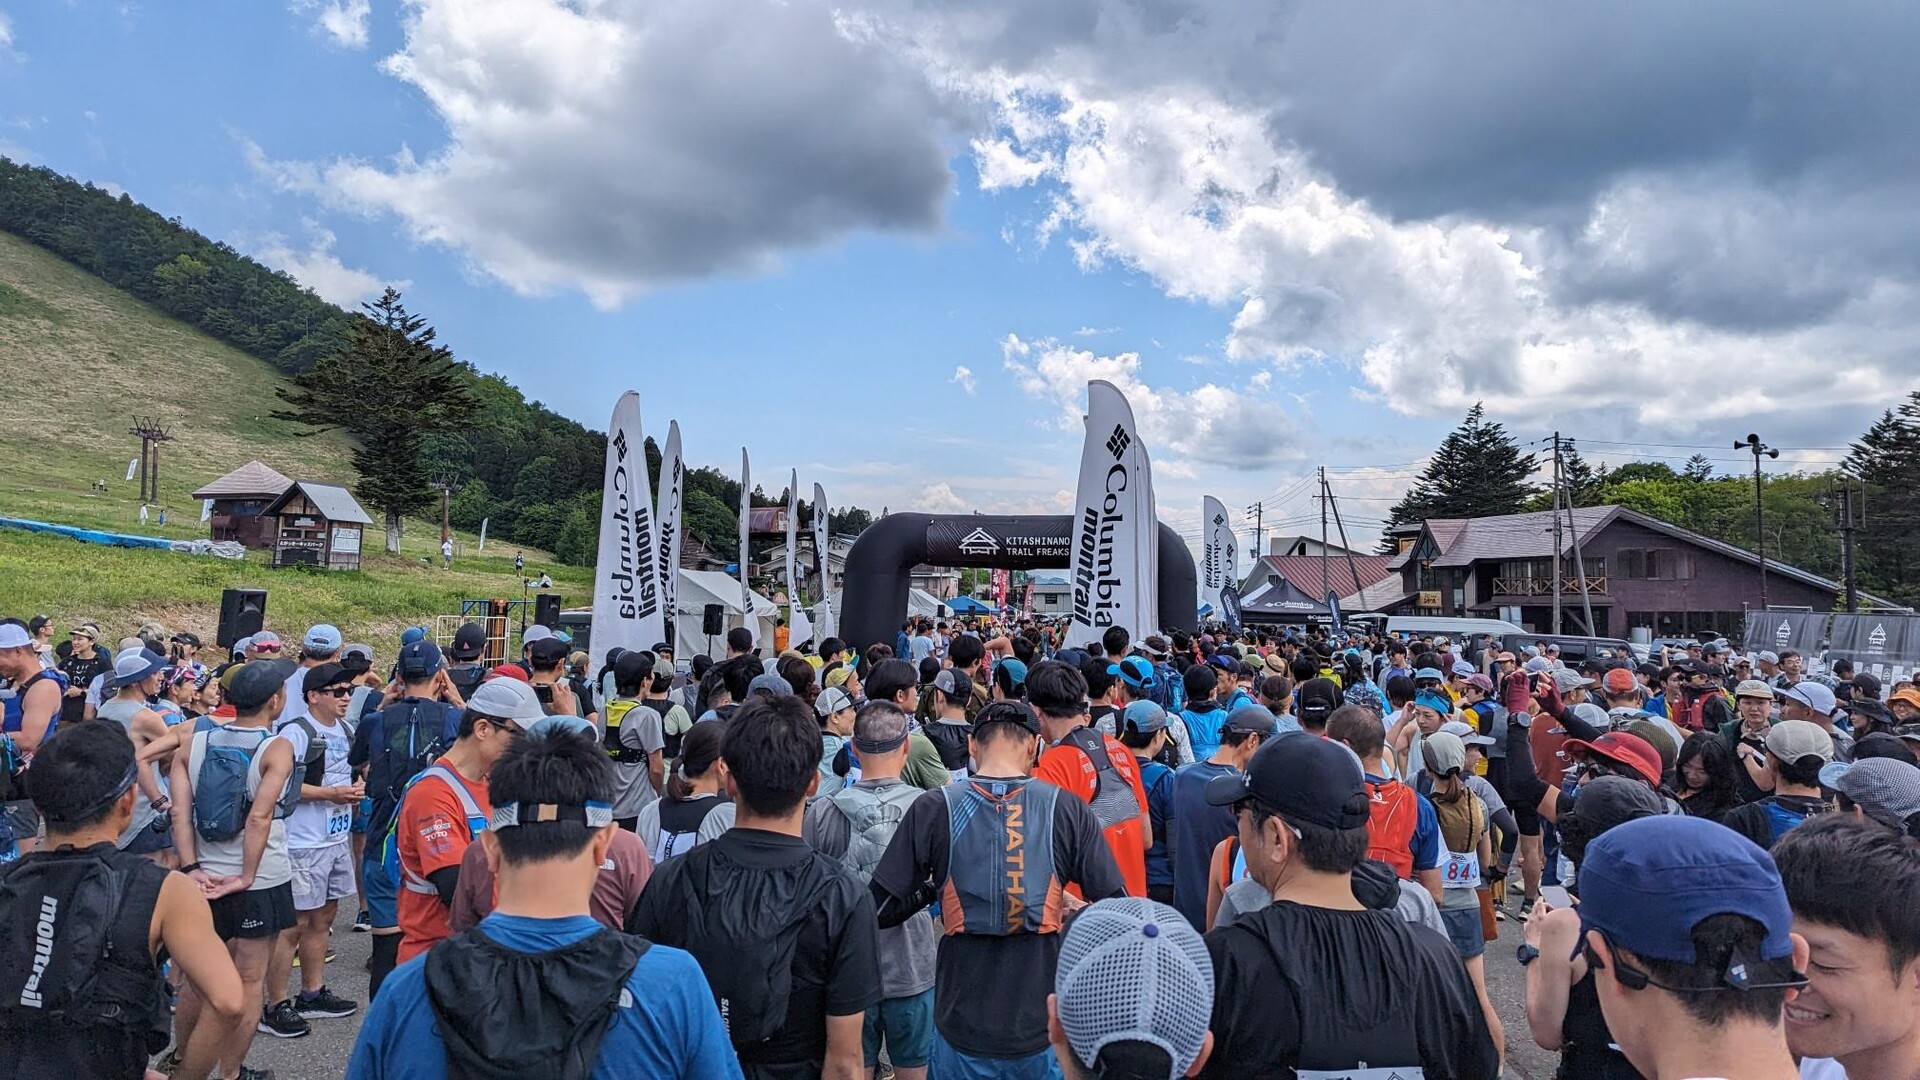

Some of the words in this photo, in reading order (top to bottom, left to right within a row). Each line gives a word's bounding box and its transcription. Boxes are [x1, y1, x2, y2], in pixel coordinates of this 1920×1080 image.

[1005, 536, 1071, 546] KITASHINANO
[1006, 547, 1034, 556] TRAIL
[1036, 547, 1070, 556] FREAKS
[1074, 506, 1099, 628] montrail
[1094, 463, 1128, 629] Columbia
[329, 813, 350, 836] 239
[1005, 803, 1026, 934] NATHAN
[1447, 860, 1479, 881] 843
[20, 894, 58, 1009] montrail
